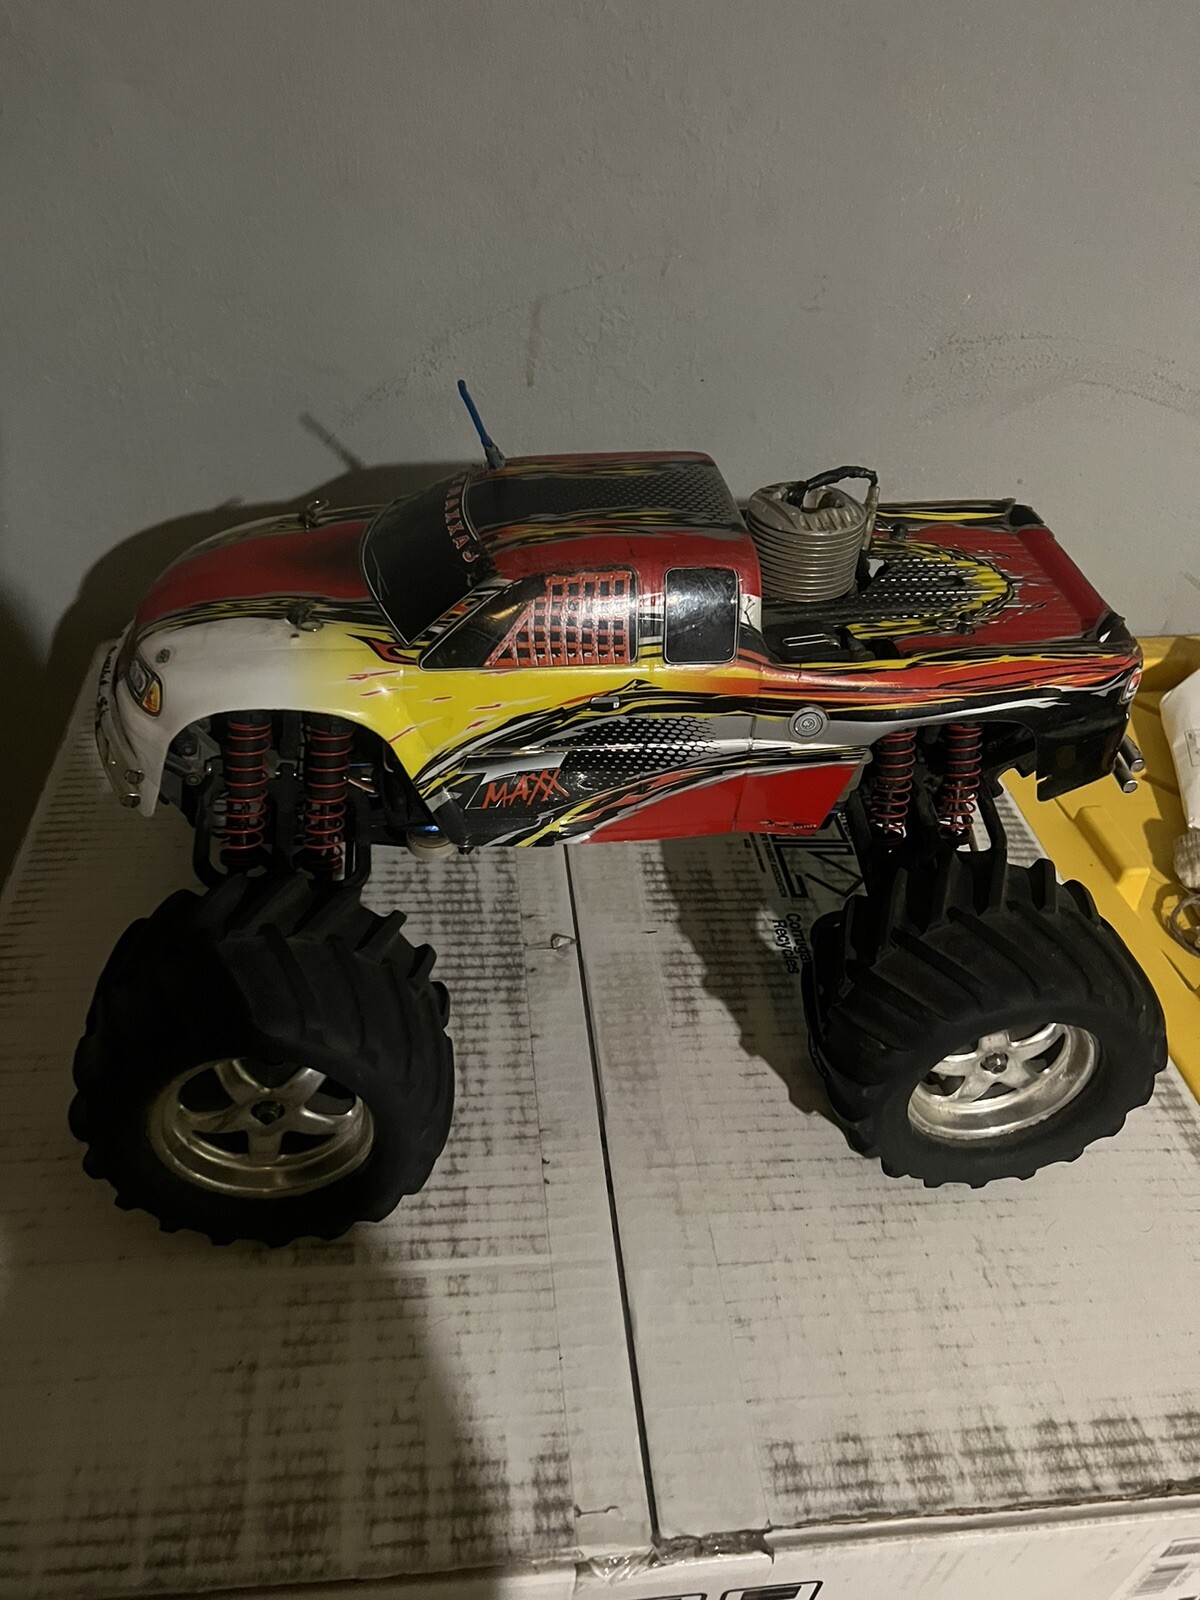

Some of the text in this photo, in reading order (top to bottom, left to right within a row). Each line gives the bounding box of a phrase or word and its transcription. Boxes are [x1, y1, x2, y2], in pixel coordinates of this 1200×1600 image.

[445, 476, 480, 563] RAXXAS
[480, 768, 570, 810] MAXX
[772, 919, 800, 975] Recycles
[786, 913, 812, 963] Corruga
